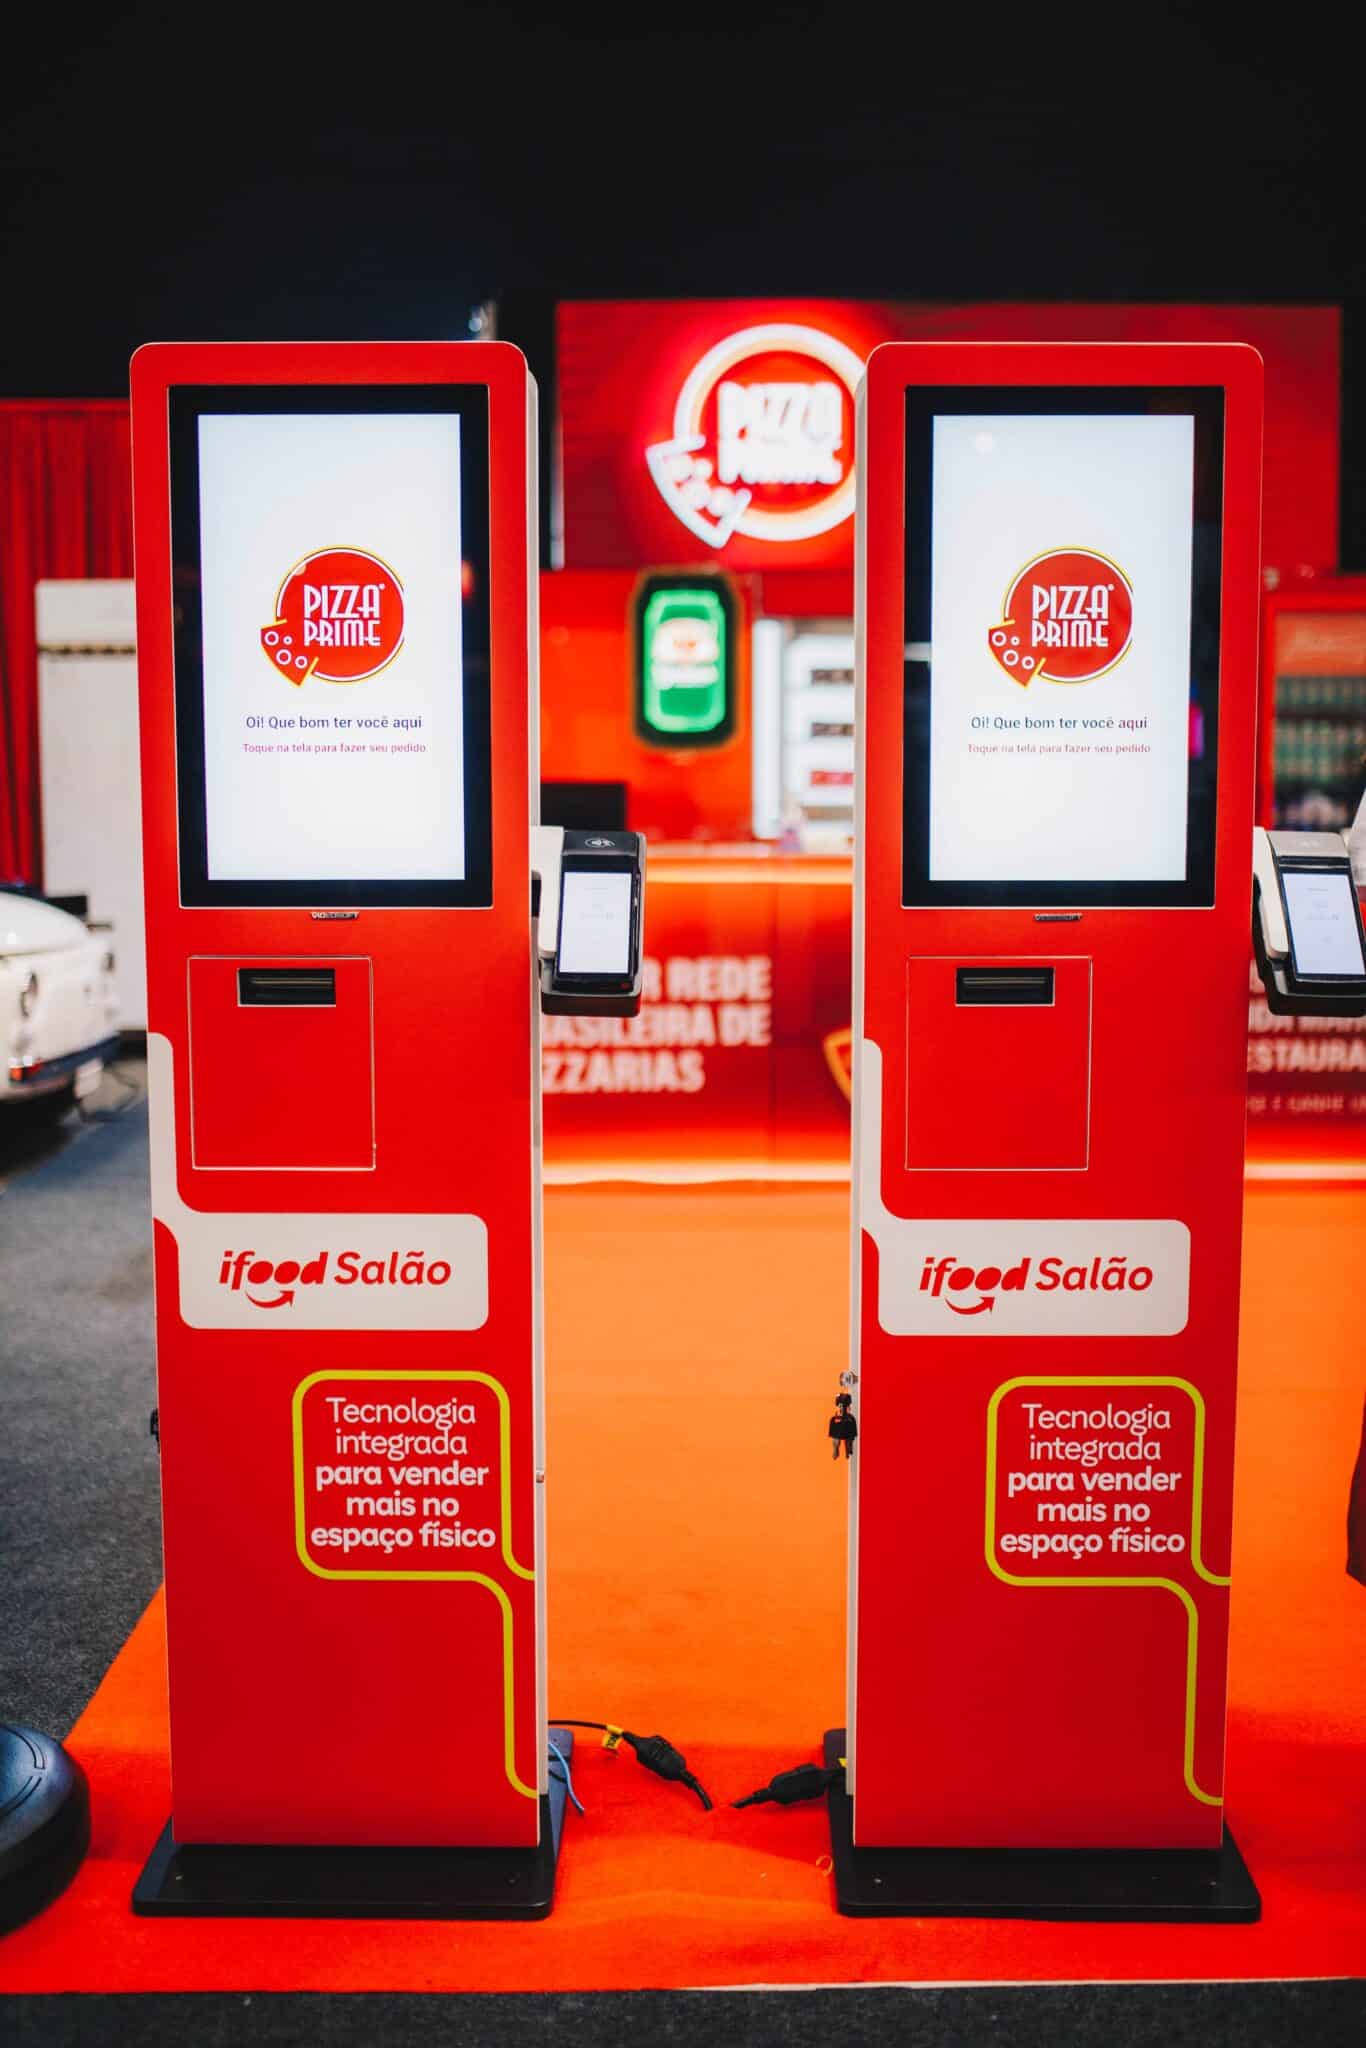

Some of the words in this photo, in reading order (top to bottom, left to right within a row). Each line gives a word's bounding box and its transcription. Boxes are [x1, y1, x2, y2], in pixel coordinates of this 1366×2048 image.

[303, 583, 380, 618] PIZZA
[1031, 583, 1109, 619] PIZZA
[303, 619, 381, 647] PRIME
[1031, 620, 1109, 648] PRIME
[246, 715, 264, 728] Oi!
[268, 715, 296, 731] Que
[299, 715, 329, 728] bom
[333, 716, 353, 728] ter
[356, 715, 388, 728] você
[393, 715, 422, 732] aqui
[971, 716, 989, 729] Oi!
[993, 716, 1021, 731] Que
[1024, 716, 1055, 729] bom
[1059, 717, 1077, 729] ter
[1081, 715, 1114, 729] você
[1118, 716, 1148, 732] aqui
[243, 743, 274, 756] Toque
[292, 743, 312, 753] tela
[314, 745, 338, 756] para
[340, 743, 366, 753] fazer
[390, 743, 426, 756] pedido
[968, 743, 999, 756] Toque
[1016, 743, 1036, 753] tela
[1039, 745, 1062, 756] para
[1065, 743, 1091, 753] fazer
[1115, 743, 1151, 756] pedido
[666, 956, 771, 1000] REDE
[542, 1003, 716, 1047] ASILEIRA
[718, 1003, 771, 1046] DE
[219, 1250, 329, 1290] ifood
[334, 1251, 452, 1285] Salão
[919, 1257, 1031, 1296] ifood
[1036, 1257, 1153, 1291] Salão
[325, 1397, 476, 1430] Tecnologia
[1021, 1403, 1171, 1436] Tecnologia
[335, 1428, 468, 1461] integrada
[1029, 1434, 1161, 1467] integrada
[316, 1464, 382, 1491] para
[388, 1460, 490, 1486] vender
[1008, 1471, 1074, 1497] para
[1081, 1466, 1182, 1491] vender
[346, 1491, 416, 1516] mais
[423, 1497, 460, 1517] no
[1037, 1497, 1106, 1522] mais
[1113, 1503, 1151, 1522] no
[311, 1527, 413, 1554] espaço
[419, 1522, 496, 1547] físico
[1000, 1532, 1103, 1560] espaço
[1109, 1527, 1186, 1553] físico
